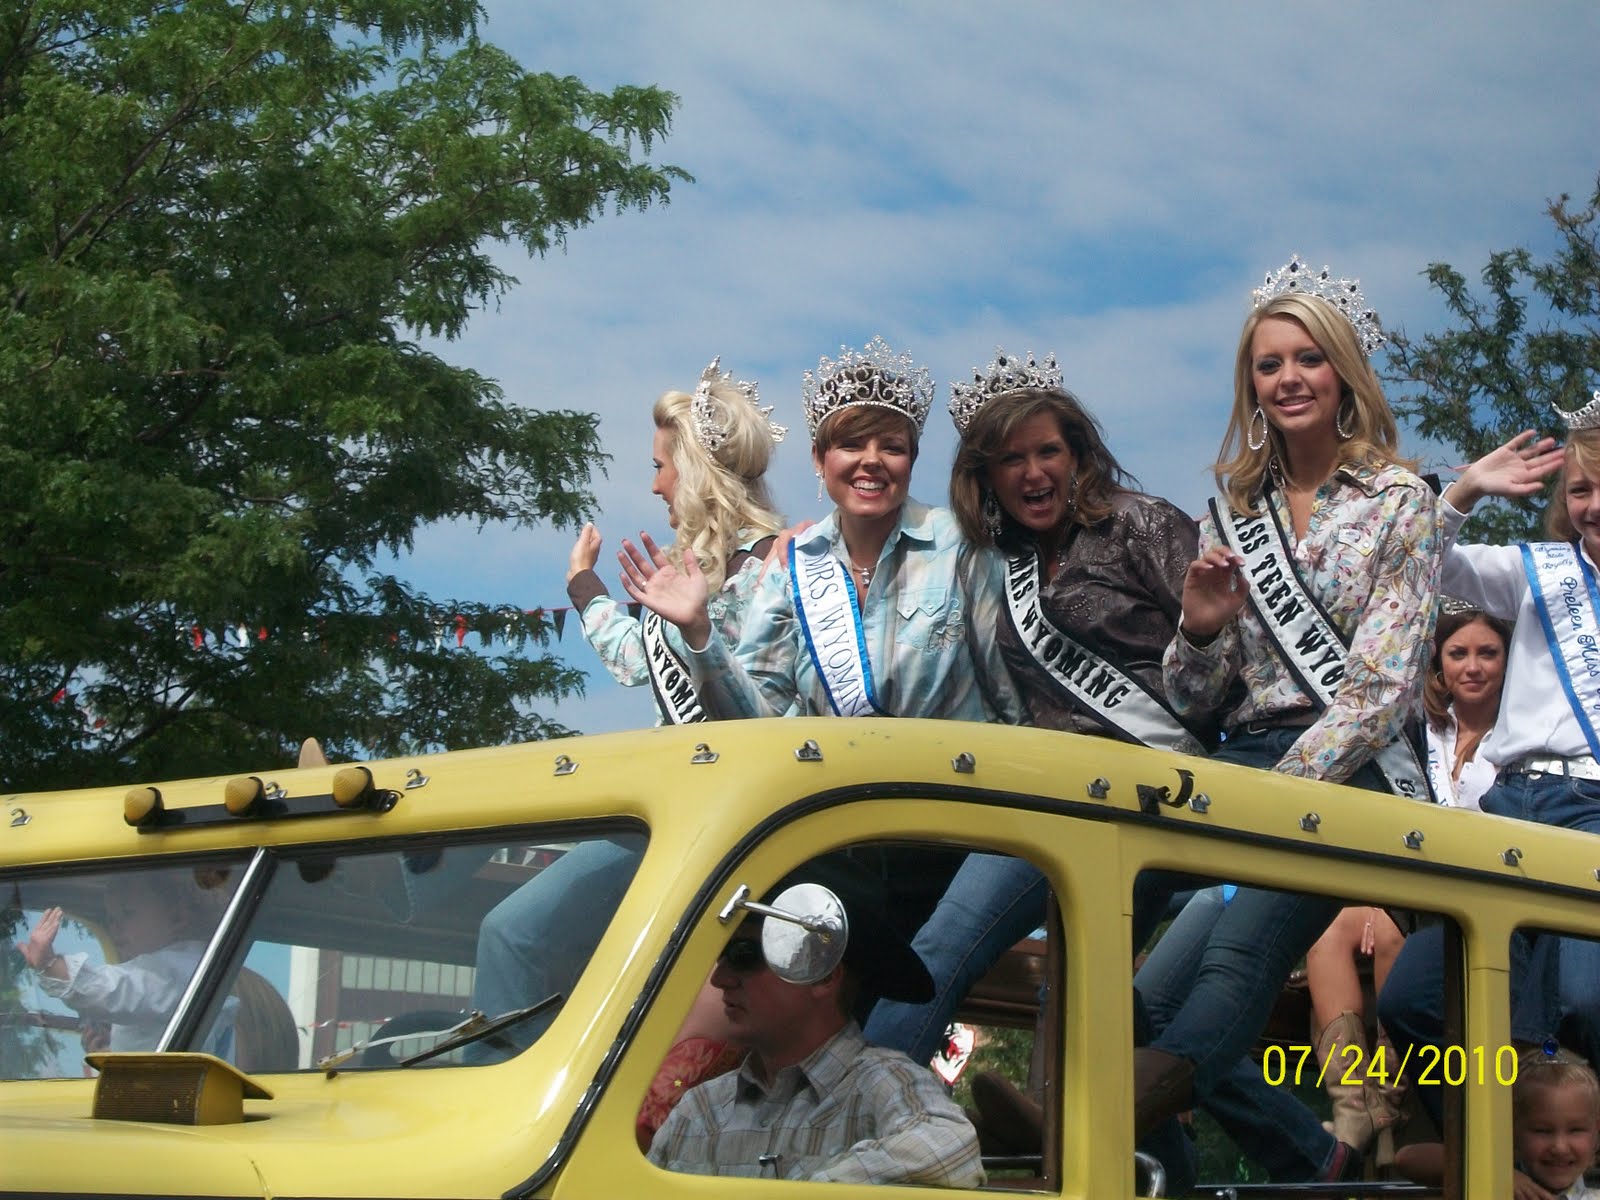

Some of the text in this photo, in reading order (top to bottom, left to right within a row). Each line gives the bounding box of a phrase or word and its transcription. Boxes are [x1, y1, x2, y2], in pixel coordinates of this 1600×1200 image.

[1009, 552, 1131, 709] MRS. WYOMING
[1250, 552, 1304, 627] TEEN
[1295, 623, 1346, 698] WYO
[1577, 634, 1600, 677] Miss
